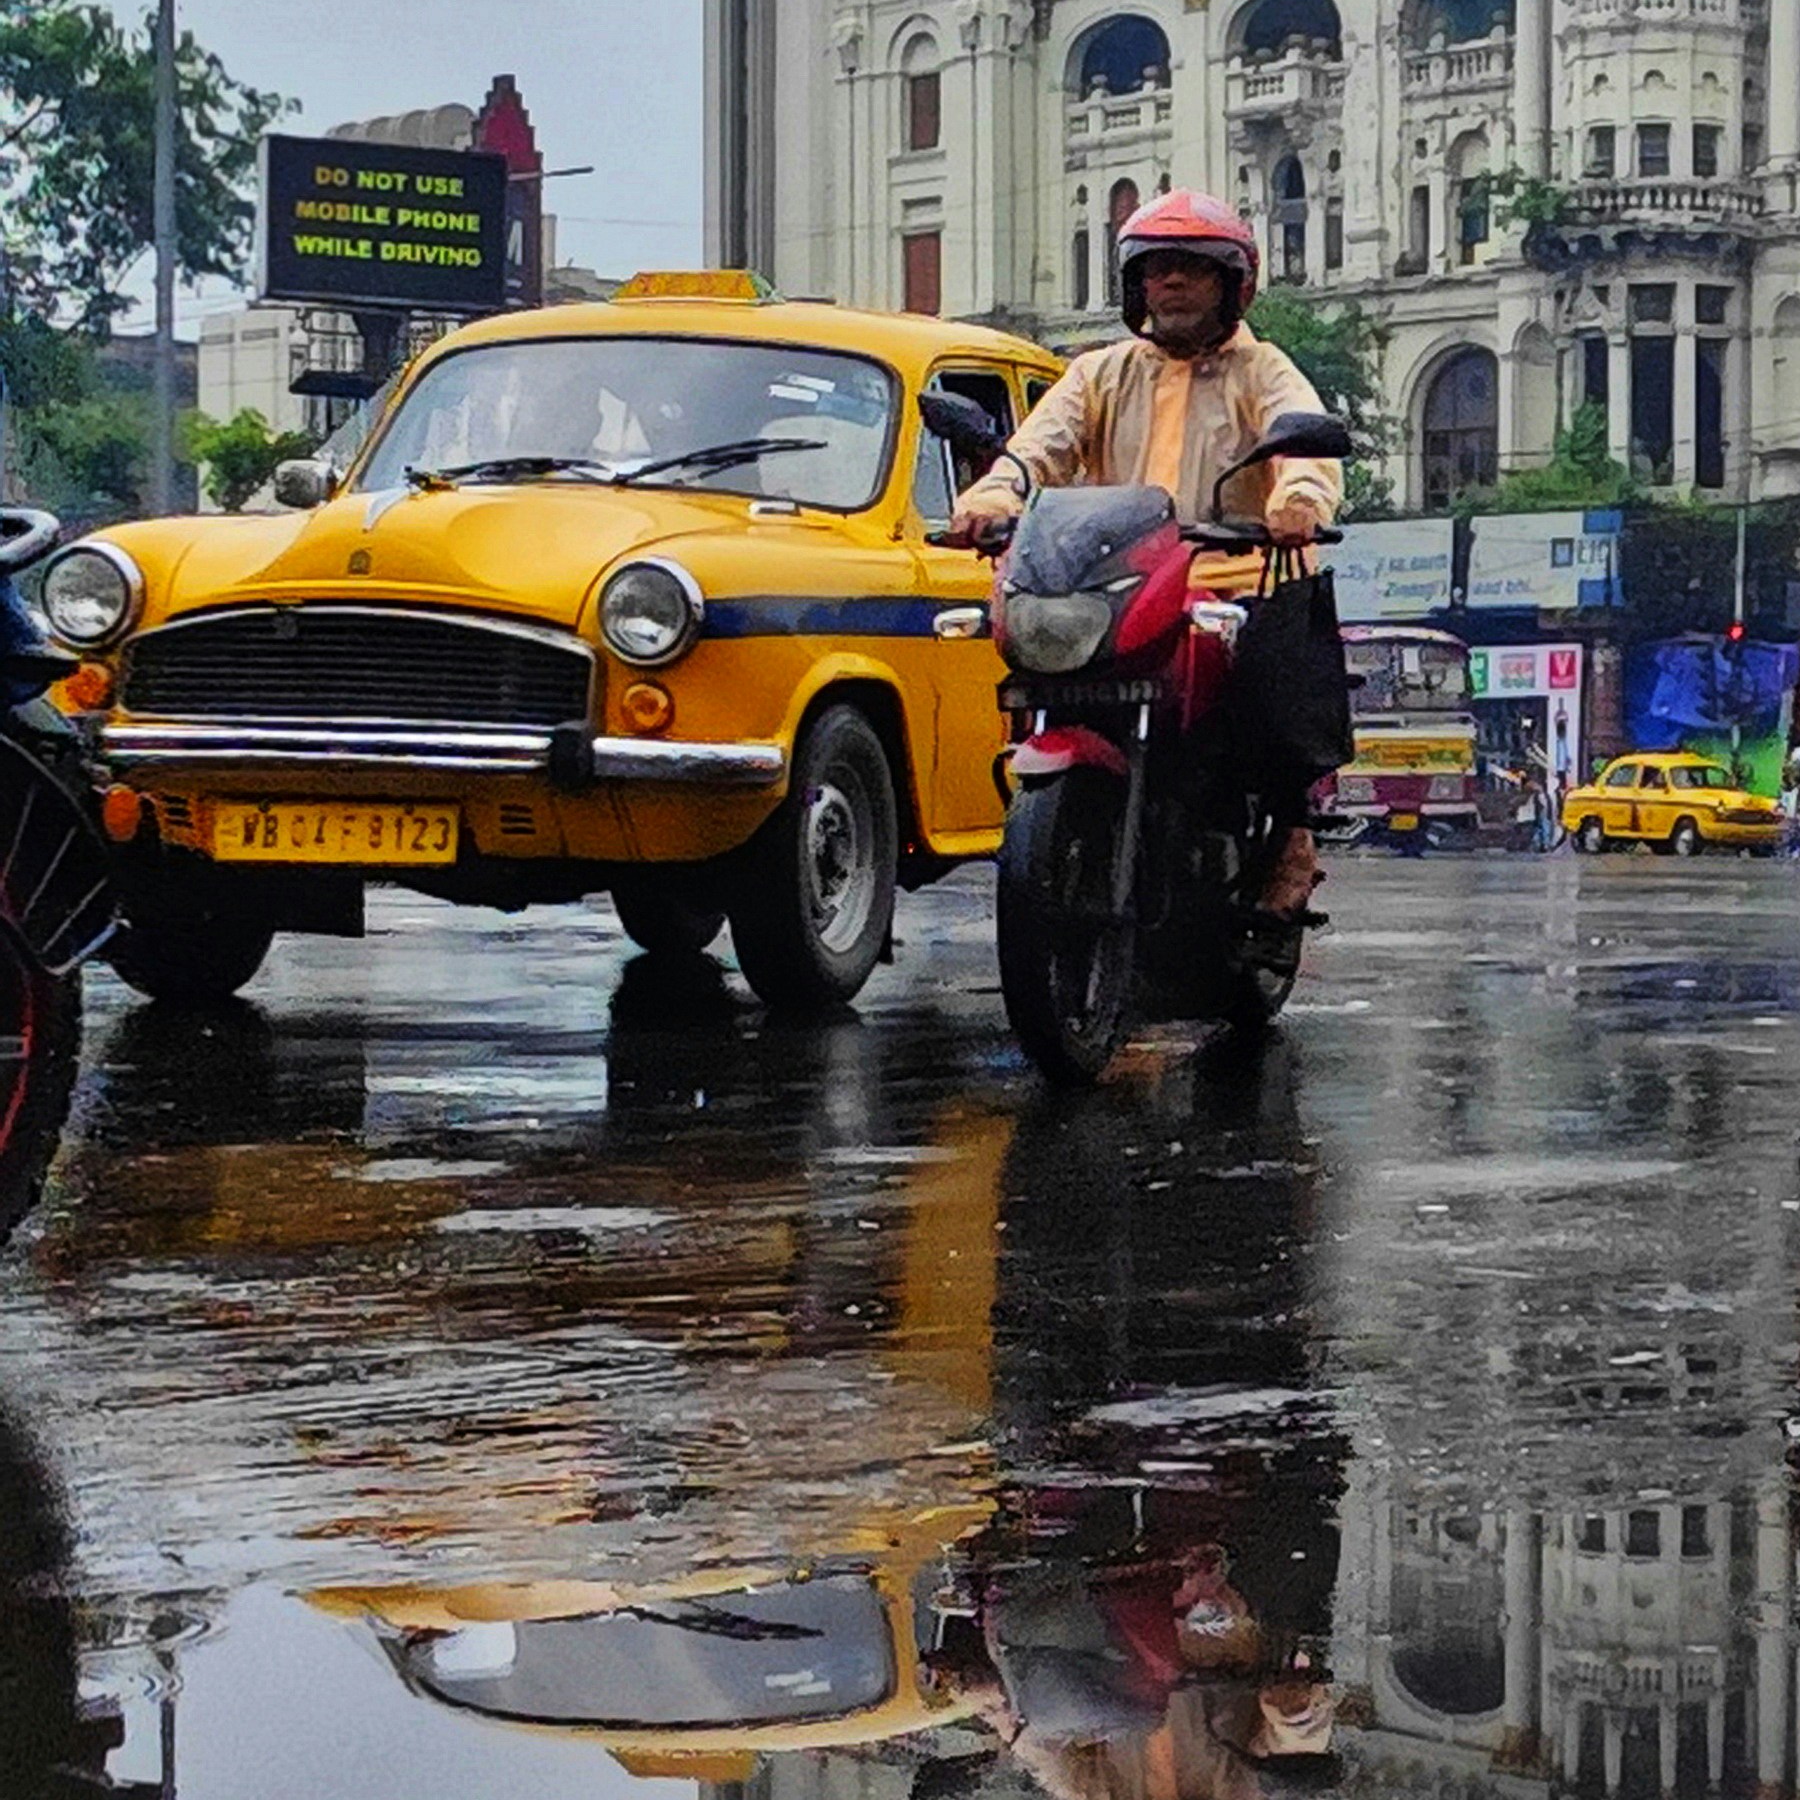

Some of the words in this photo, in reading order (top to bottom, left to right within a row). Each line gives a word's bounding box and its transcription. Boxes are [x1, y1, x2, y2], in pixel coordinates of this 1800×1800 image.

[315, 166, 348, 186] DO
[356, 170, 407, 193] NOT
[415, 175, 464, 197] USE
[296, 200, 391, 225] MOBILE
[397, 208, 481, 232] PHONE
[293, 234, 373, 258] WHILE
[380, 242, 482, 267] DRIVING
[368, 814, 450, 852] 8123
